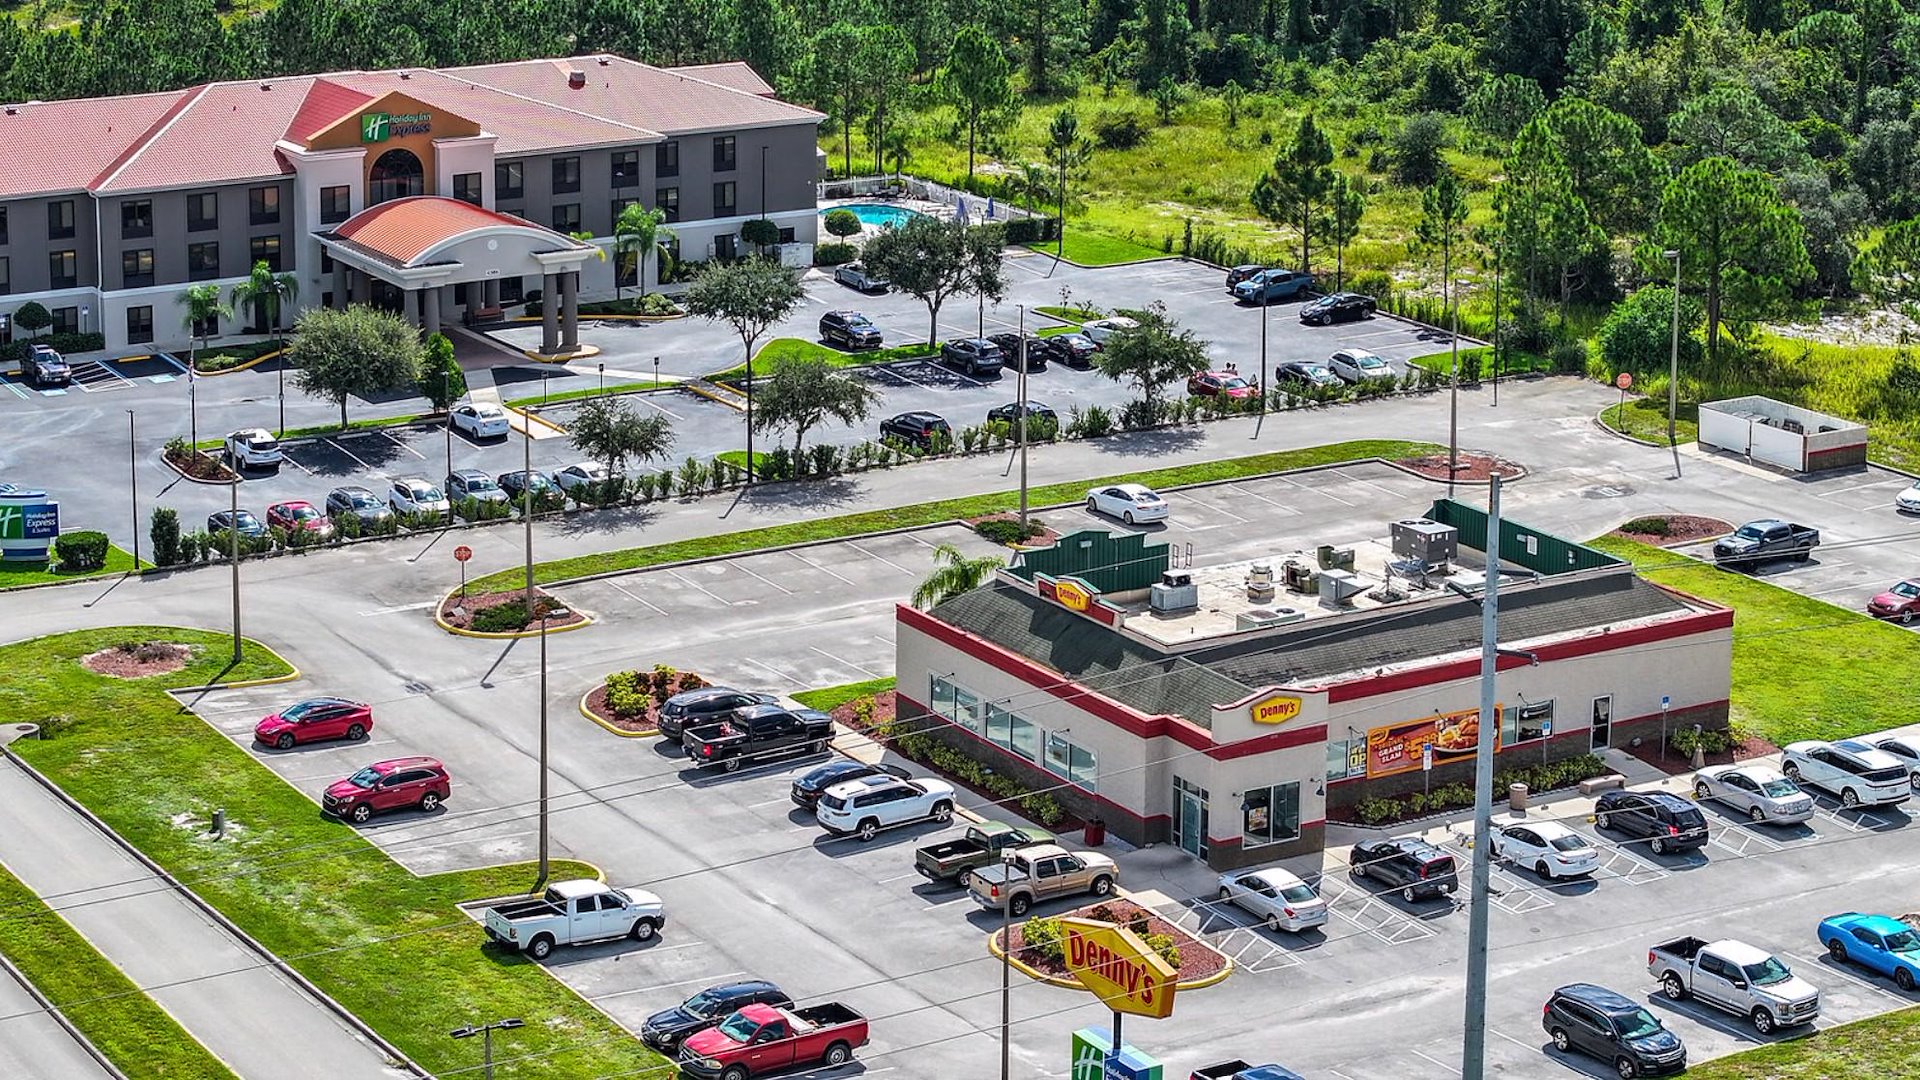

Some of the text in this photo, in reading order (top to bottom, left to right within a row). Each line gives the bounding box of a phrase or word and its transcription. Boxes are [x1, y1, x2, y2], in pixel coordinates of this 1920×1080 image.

[389, 112, 432, 124] Holiday Inn
[26, 519, 56, 528] Express
[1059, 586, 1081, 604] Denny's
[1261, 702, 1295, 718] Denny's
[1378, 743, 1403, 757] GRAND
[1381, 751, 1401, 763] SLAM
[1068, 930, 1154, 1005] Denny's
